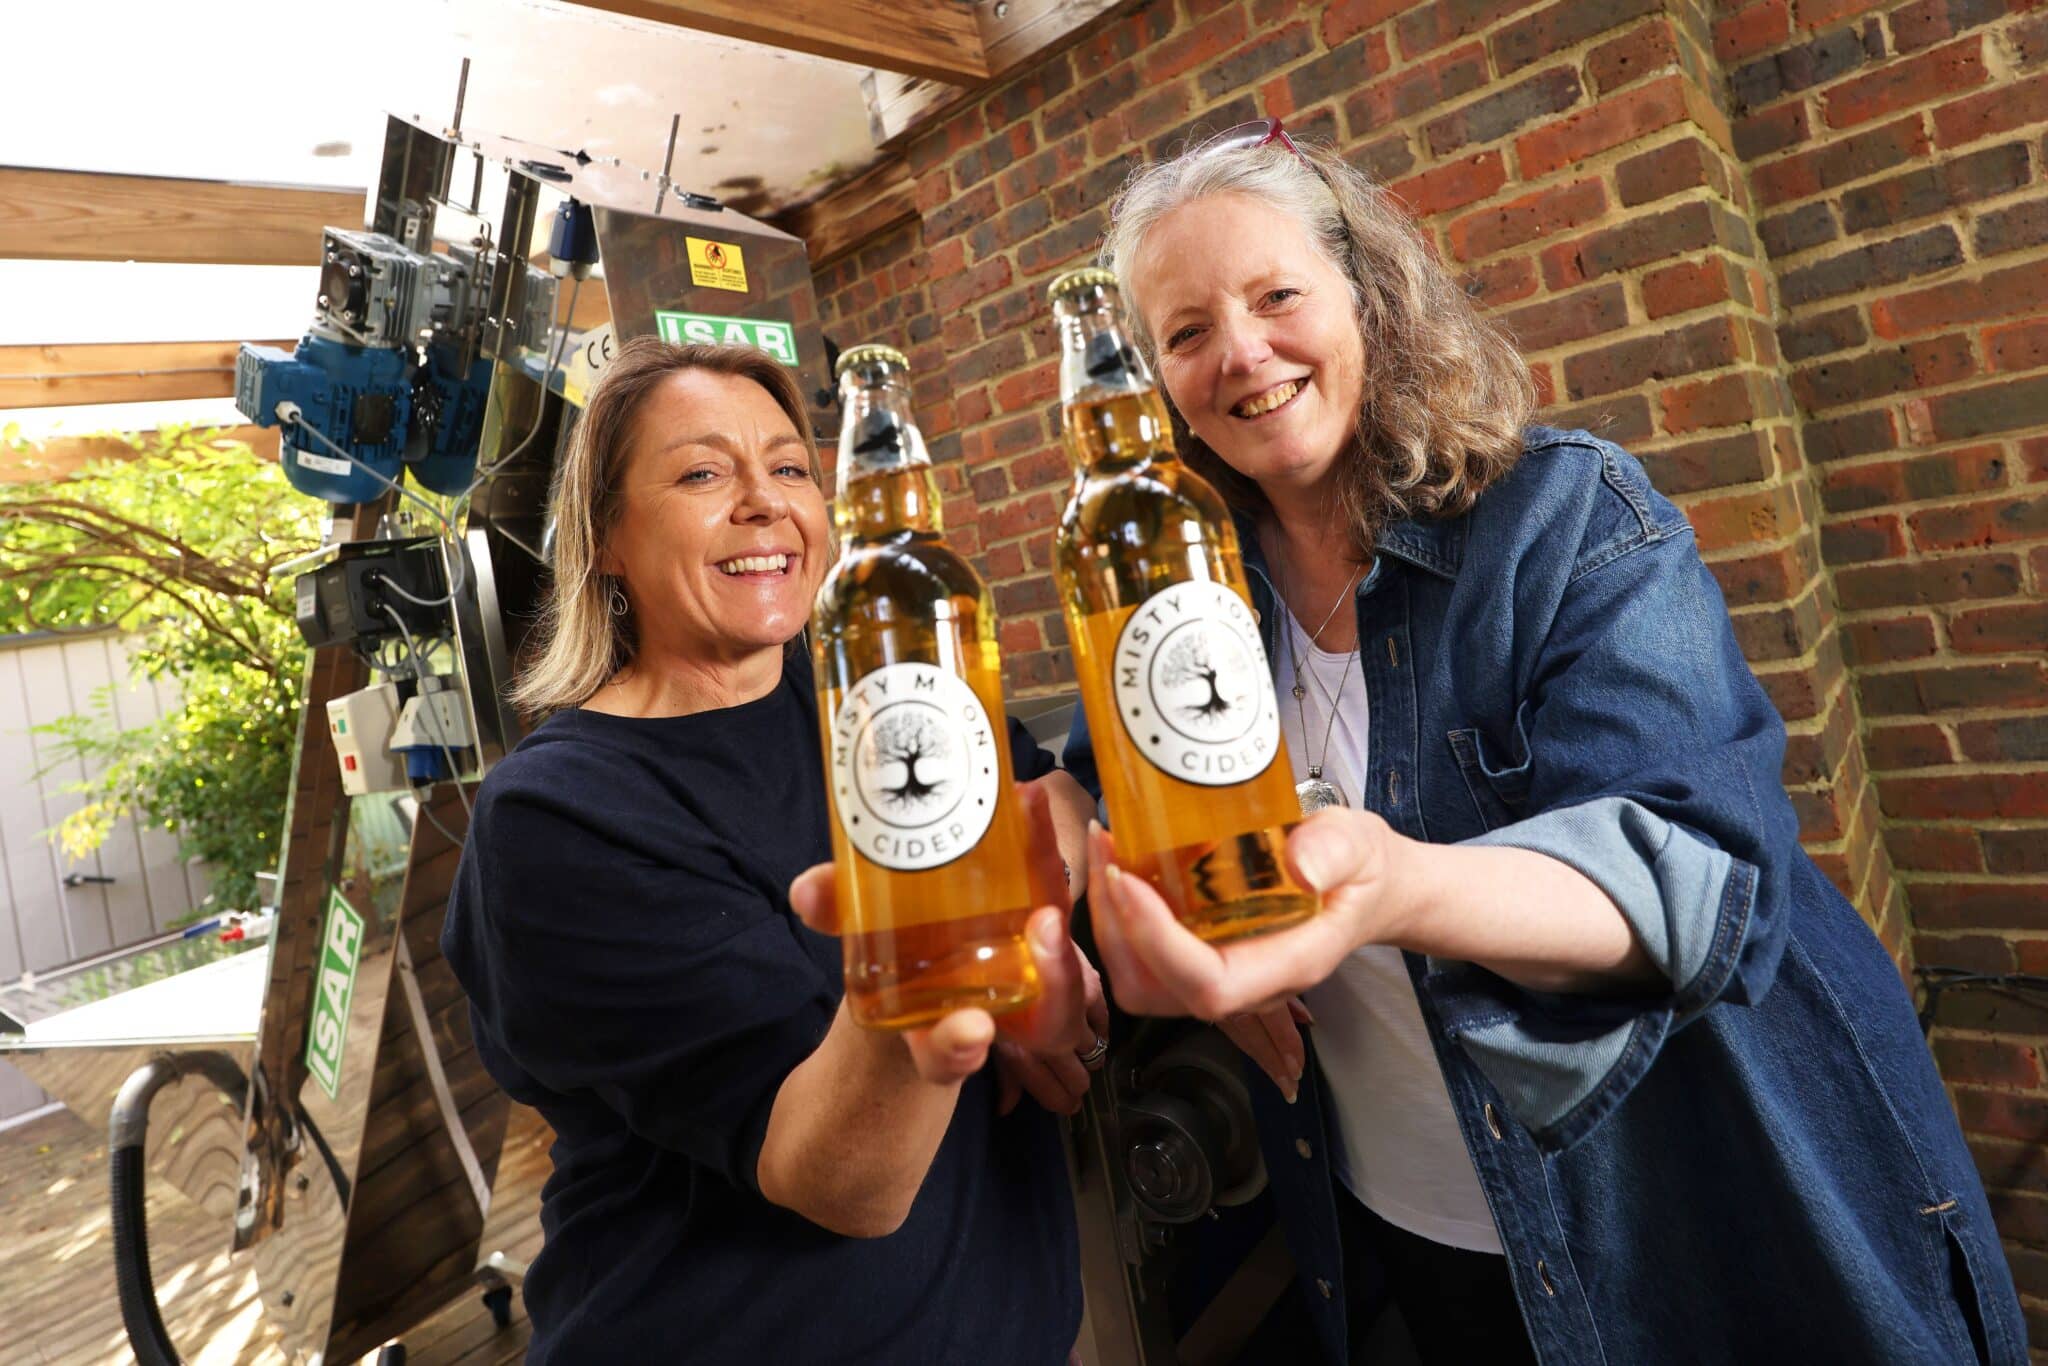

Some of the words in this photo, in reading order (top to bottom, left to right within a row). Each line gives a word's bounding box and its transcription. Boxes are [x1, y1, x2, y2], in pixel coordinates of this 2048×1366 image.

[664, 317, 790, 359] ISAR
[1122, 593, 1182, 688] MISTY
[836, 676, 889, 767] MISTY
[914, 672, 988, 747] MON
[1181, 736, 1268, 775] CIDER
[872, 822, 965, 859] CIDER
[311, 906, 358, 1086] ISAR
